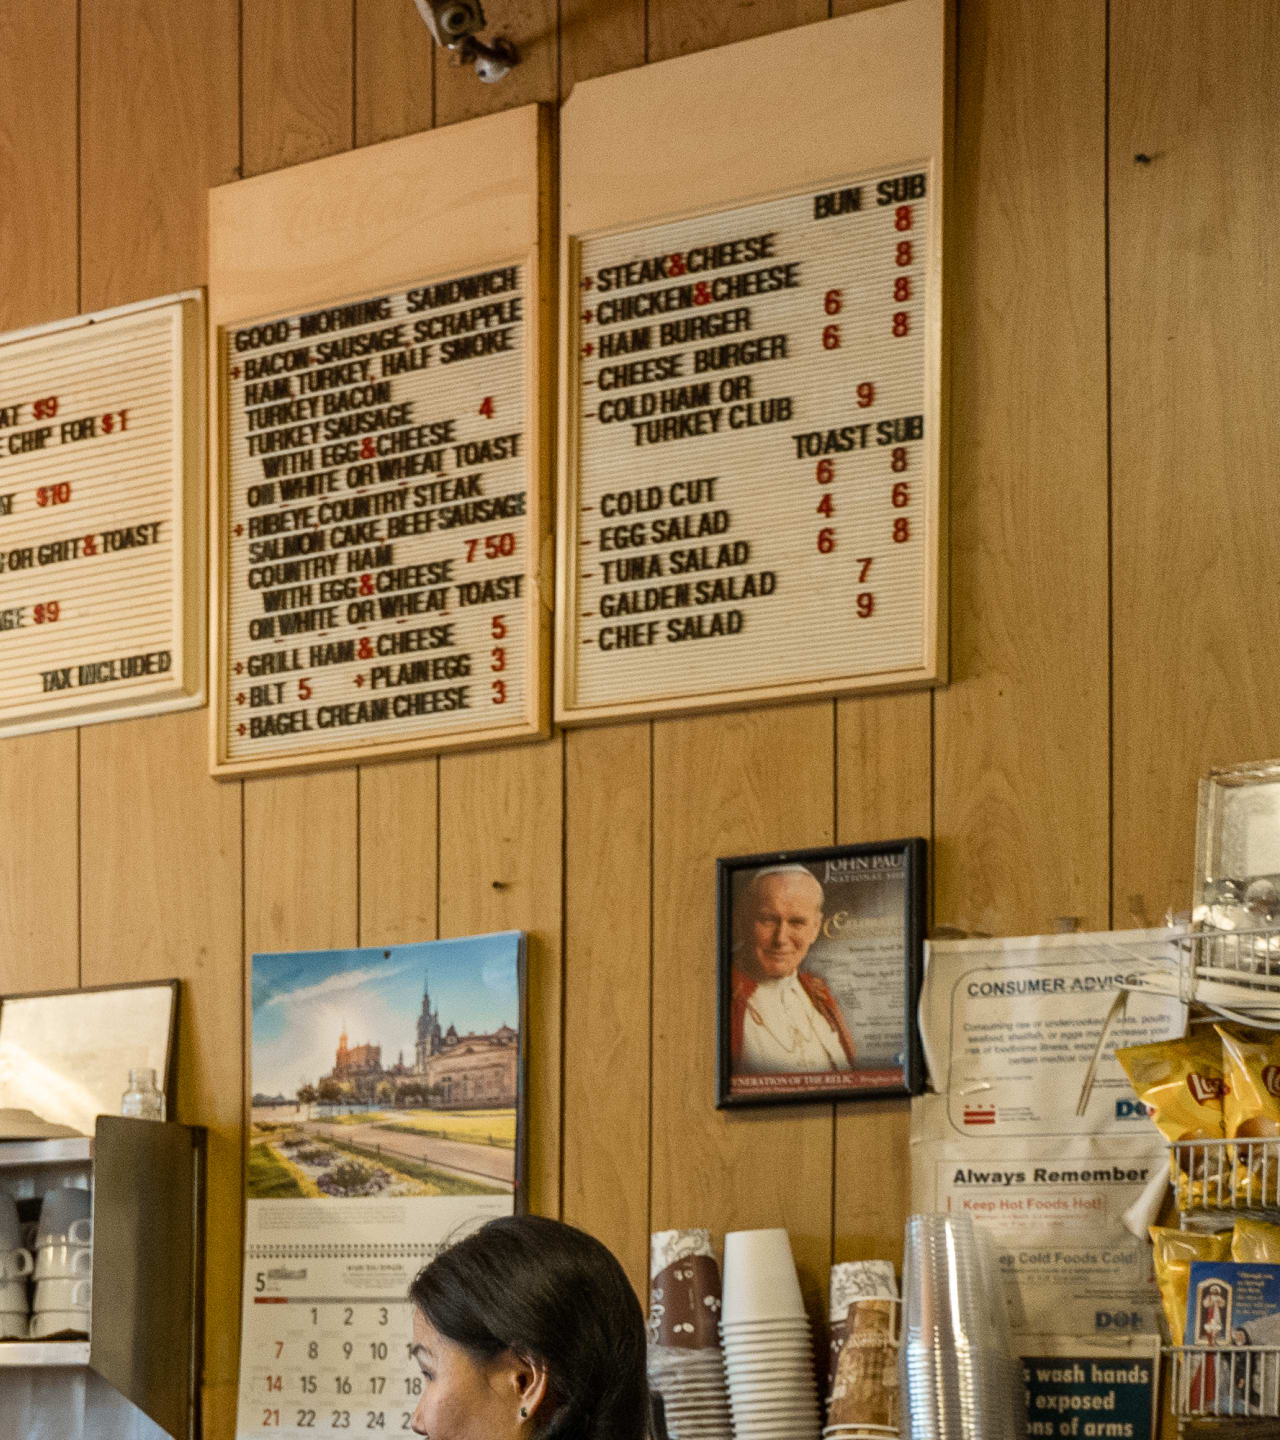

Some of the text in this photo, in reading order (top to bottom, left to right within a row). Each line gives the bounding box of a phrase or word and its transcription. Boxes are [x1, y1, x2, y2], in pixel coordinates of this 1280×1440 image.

[814, 173, 926, 220] BUN SUB
[895, 205, 913, 231] 8
[896, 241, 913, 266] 8
[406, 265, 520, 313] SANDWICH
[413, 298, 523, 343] SCRAPPLE
[599, 276, 911, 358] HAM BURGER 6 8
[382, 345, 434, 377] HALF
[440, 327, 517, 364] SMOKE
[598, 312, 910, 391] CHEESE BURGER 6 8
[33, 396, 59, 420] $9
[246, 380, 391, 431] TURKEY BACON
[479, 396, 494, 419] 4
[598, 375, 752, 423] COLD HAM OR
[632, 382, 875, 445] TURKEY CLUB 9
[9, 417, 96, 455] CHIP FOR
[246, 402, 415, 456] TURKEY SAUSAGE
[793, 415, 923, 459] TOAST SUB
[263, 450, 313, 479] WITH
[279, 433, 523, 500] WHITE OR WHEAT TOAST
[600, 447, 907, 517] COLD CUT 6 8
[36, 481, 72, 507] $10
[318, 488, 408, 525] COUNTRY
[413, 473, 483, 507] STEAK
[248, 531, 326, 564] SALMON
[388, 510, 436, 539] BEEF
[438, 492, 526, 530] SAUSAGE
[599, 482, 909, 551] EGG SALAD 4 6
[9, 548, 33, 571] OR
[248, 544, 392, 590] COUNTRY HAM
[464, 532, 516, 563] 7 50
[599, 517, 910, 585] TUNA SALAD 6 8
[599, 558, 873, 619] GALDEN SALAD 7
[598, 592, 874, 650] CHEF SALAD 9
[247, 615, 507, 677] GRILL 5
[40, 650, 172, 692] TAX INCLUDED
[250, 647, 506, 708] BLT 5 PLAIN EGG 3
[250, 680, 507, 739] BAGEL CREAM CHEESE 3
[872, 854, 906, 868] PAU
[967, 976, 1065, 998] CONSUMER
[954, 1166, 1149, 1186] Always Remember
[963, 1201, 995, 1212] Keep
[1000, 1200, 1022, 1210] Hot
[1027, 1198, 1068, 1209] Foods
[1019, 1252, 1050, 1265] Cold
[1055, 1252, 1098, 1264] Foods
[255, 1272, 266, 1292] 5
[310, 1308, 388, 1325] 1 2 3
[275, 1341, 387, 1360] 7 8 9 10
[266, 1375, 422, 1395] 14 15 16 17 18
[1036, 1364, 1149, 1384] wash hands
[262, 1408, 386, 1429] 21 22 23 24
[1035, 1390, 1115, 1413] exposed
[1060, 1417, 1133, 1437] of arms
